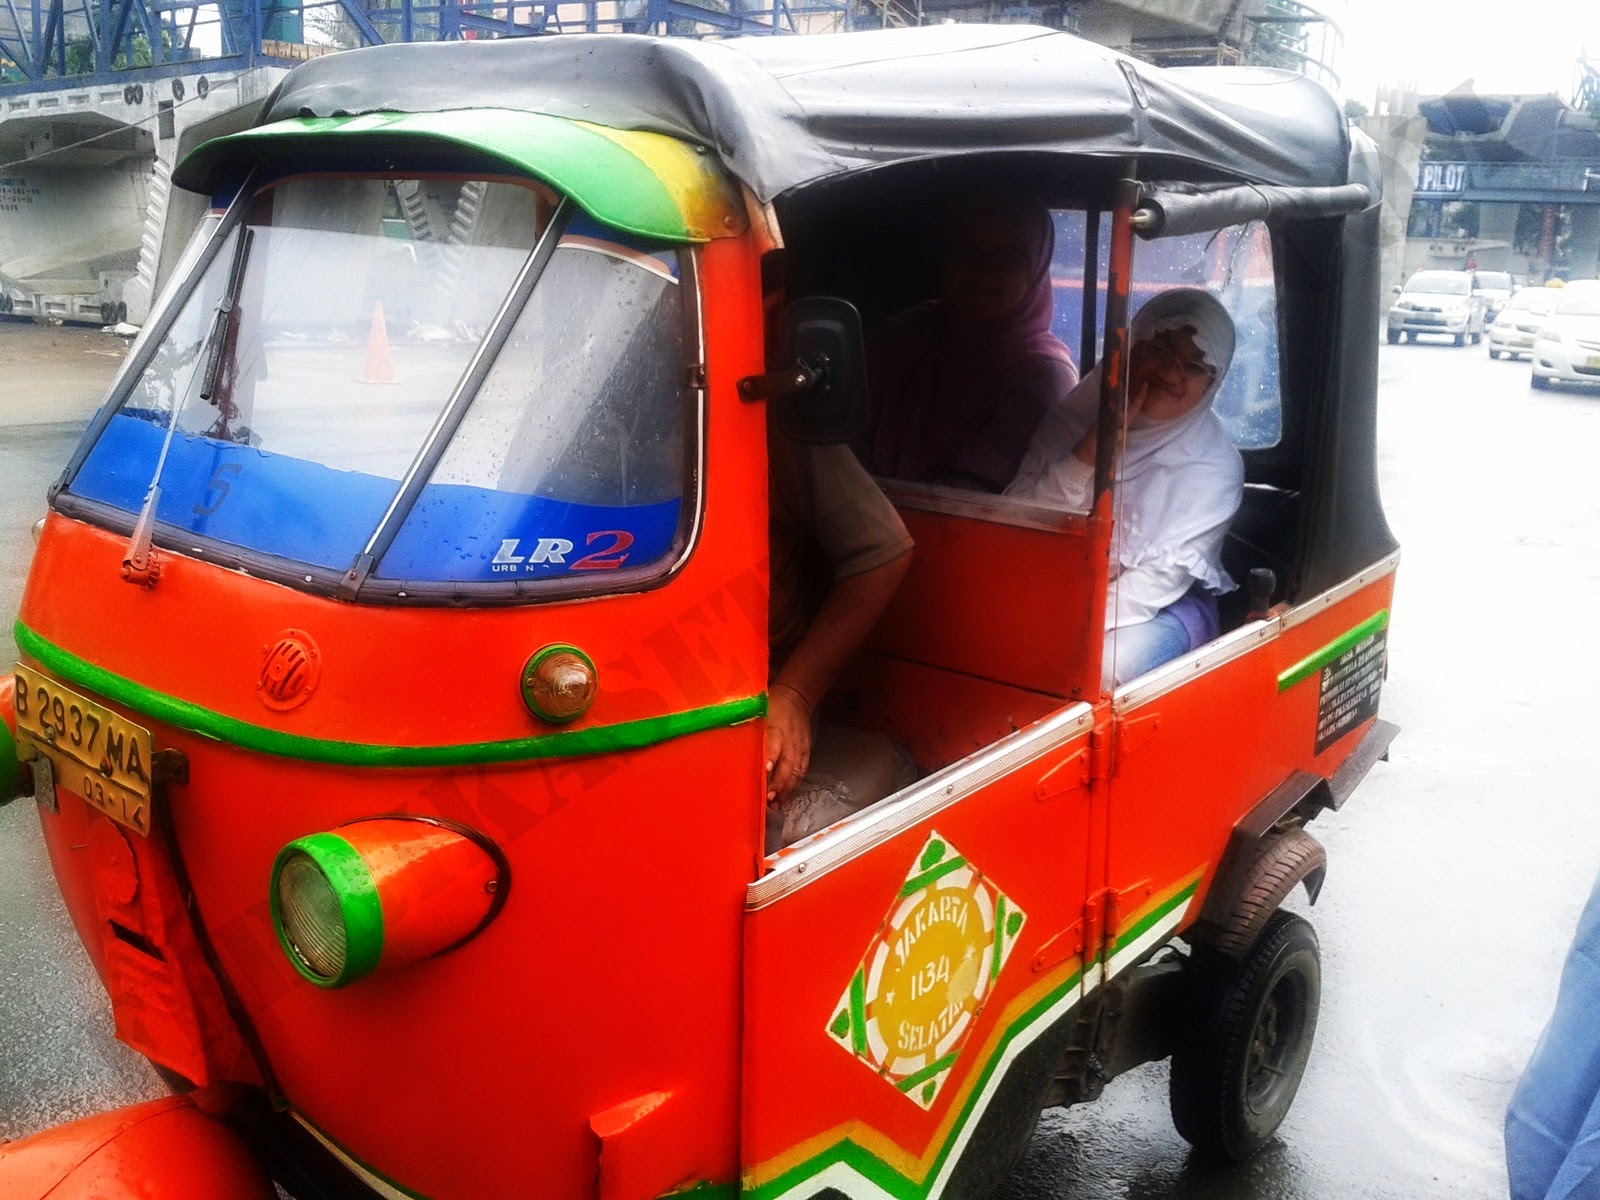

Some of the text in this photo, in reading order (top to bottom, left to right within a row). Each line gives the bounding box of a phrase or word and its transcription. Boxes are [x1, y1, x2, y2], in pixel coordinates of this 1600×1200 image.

[1422, 164, 1466, 191] PILOT
[15, 674, 151, 785] B 2937 MA
